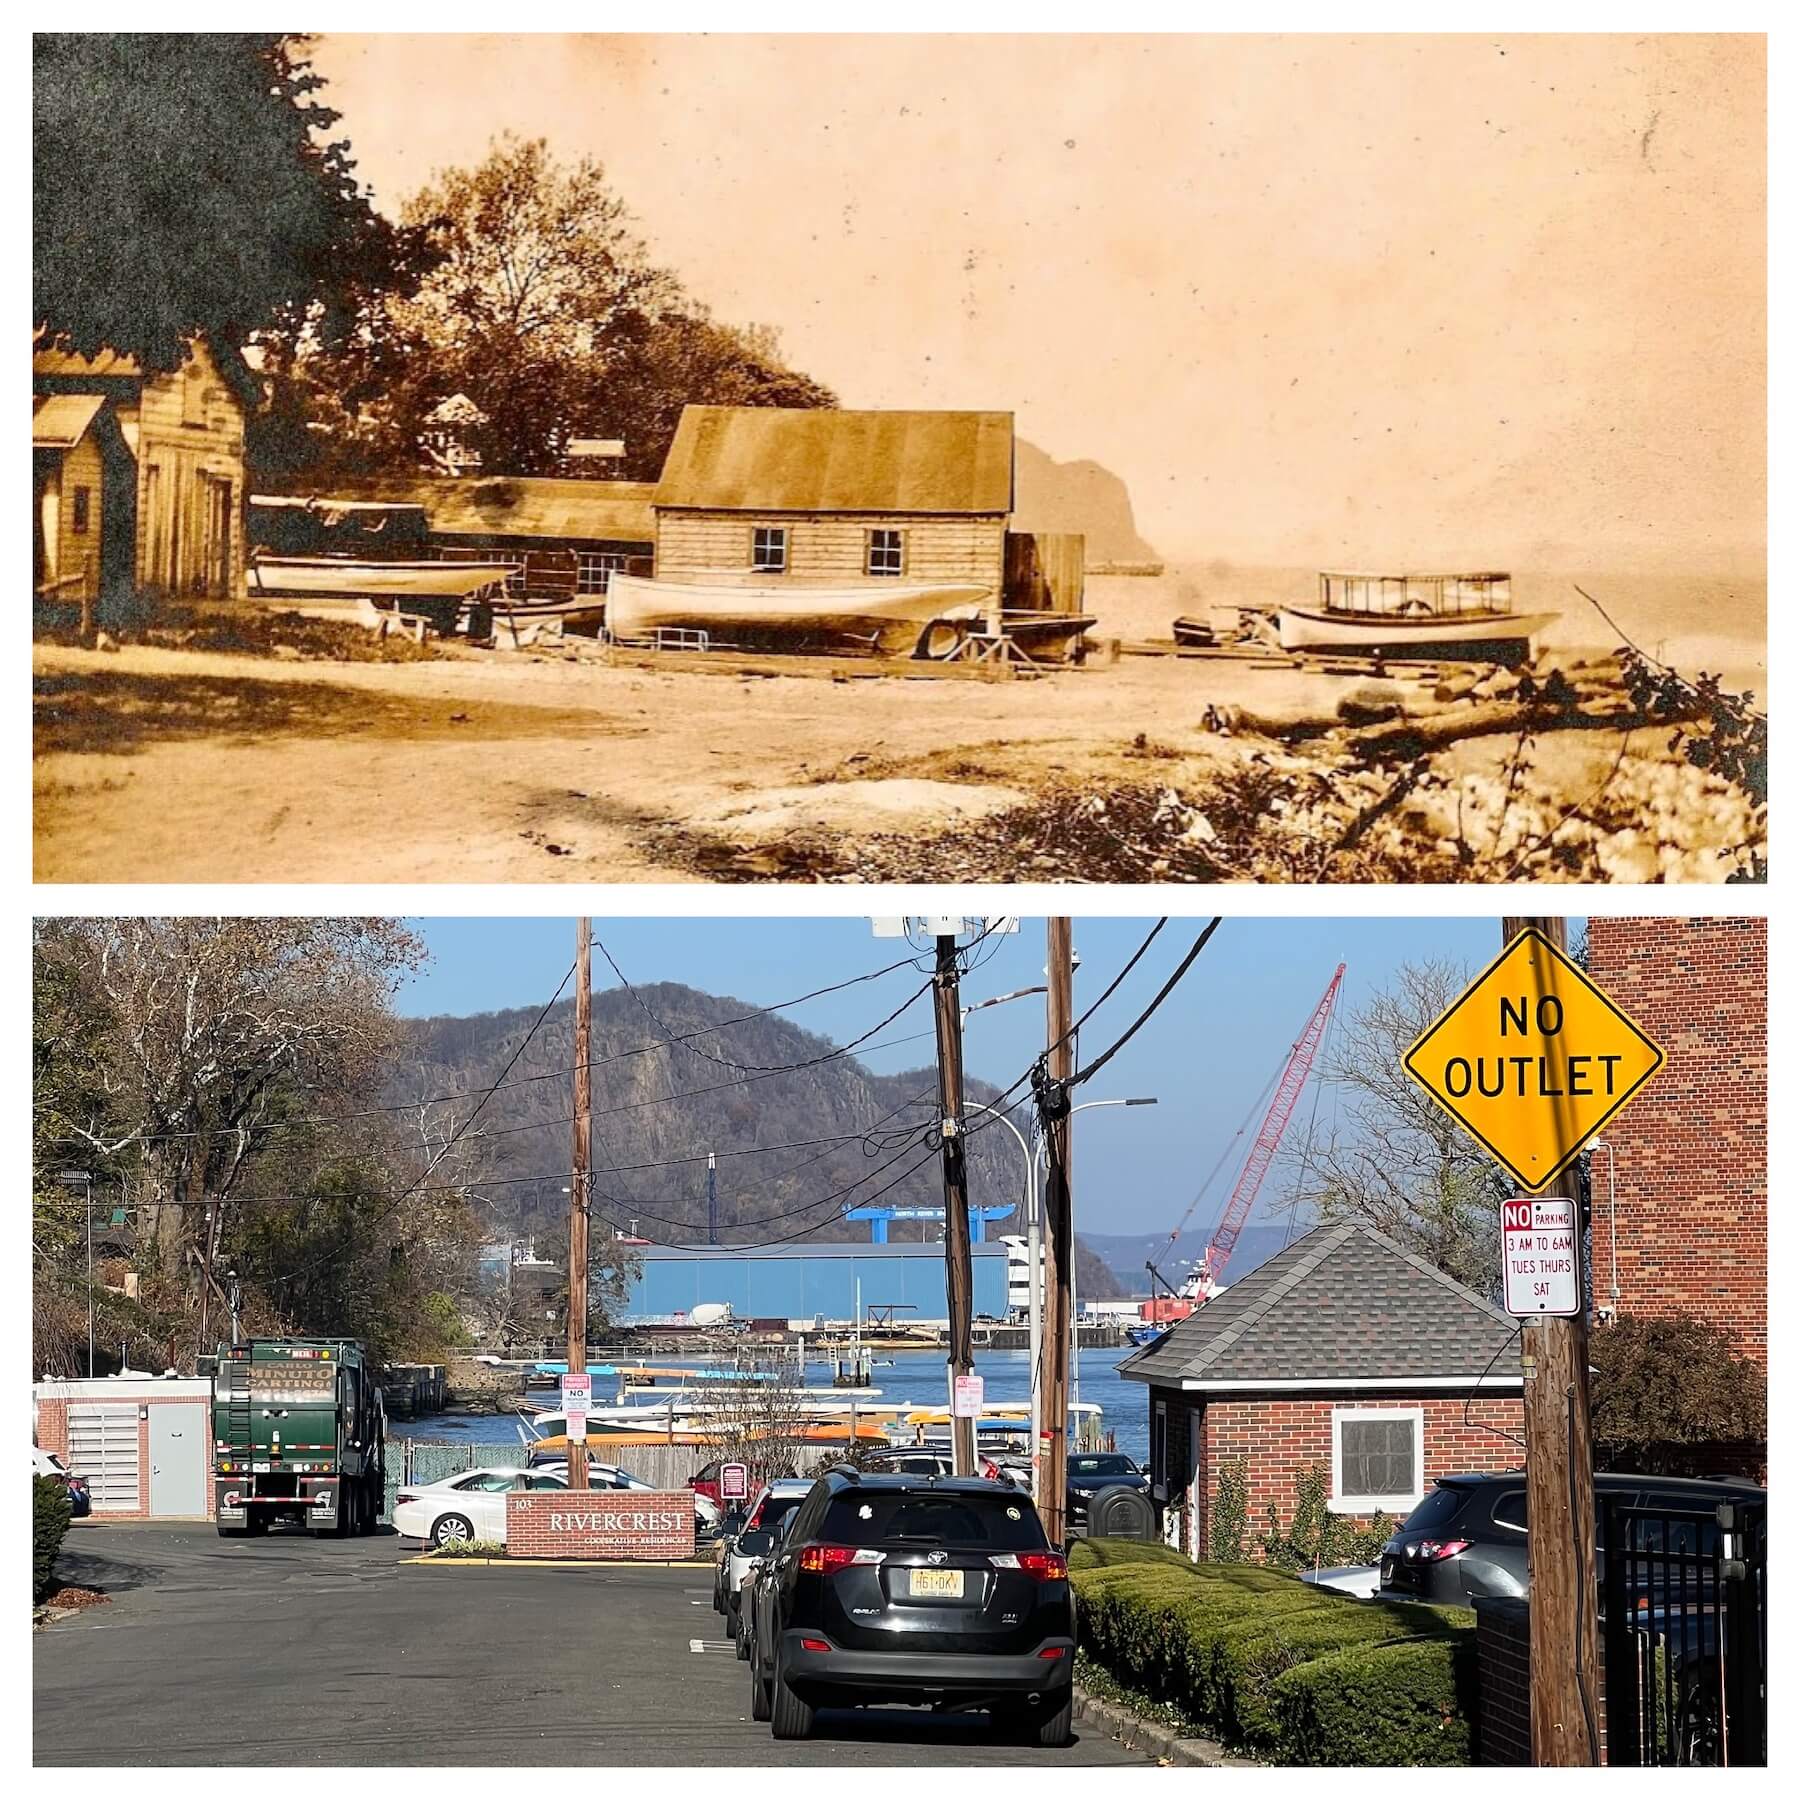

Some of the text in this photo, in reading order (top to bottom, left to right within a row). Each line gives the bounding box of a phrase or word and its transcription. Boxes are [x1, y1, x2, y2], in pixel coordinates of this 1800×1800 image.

[1500, 995, 1564, 1037] NO
[1444, 1055, 1622, 1098] OUTLET
[1505, 1205, 1569, 1227] NO PARKING
[1508, 1236, 1573, 1252] 3 AM TO 6AM
[1511, 1259, 1571, 1274] TUES THURS
[1533, 1282, 1550, 1297] SAT
[246, 1369, 333, 1380] MINUTO
[246, 1379, 325, 1388] CARTING
[515, 1500, 533, 1510] 103
[550, 1512, 686, 1531] RIVERCREST
